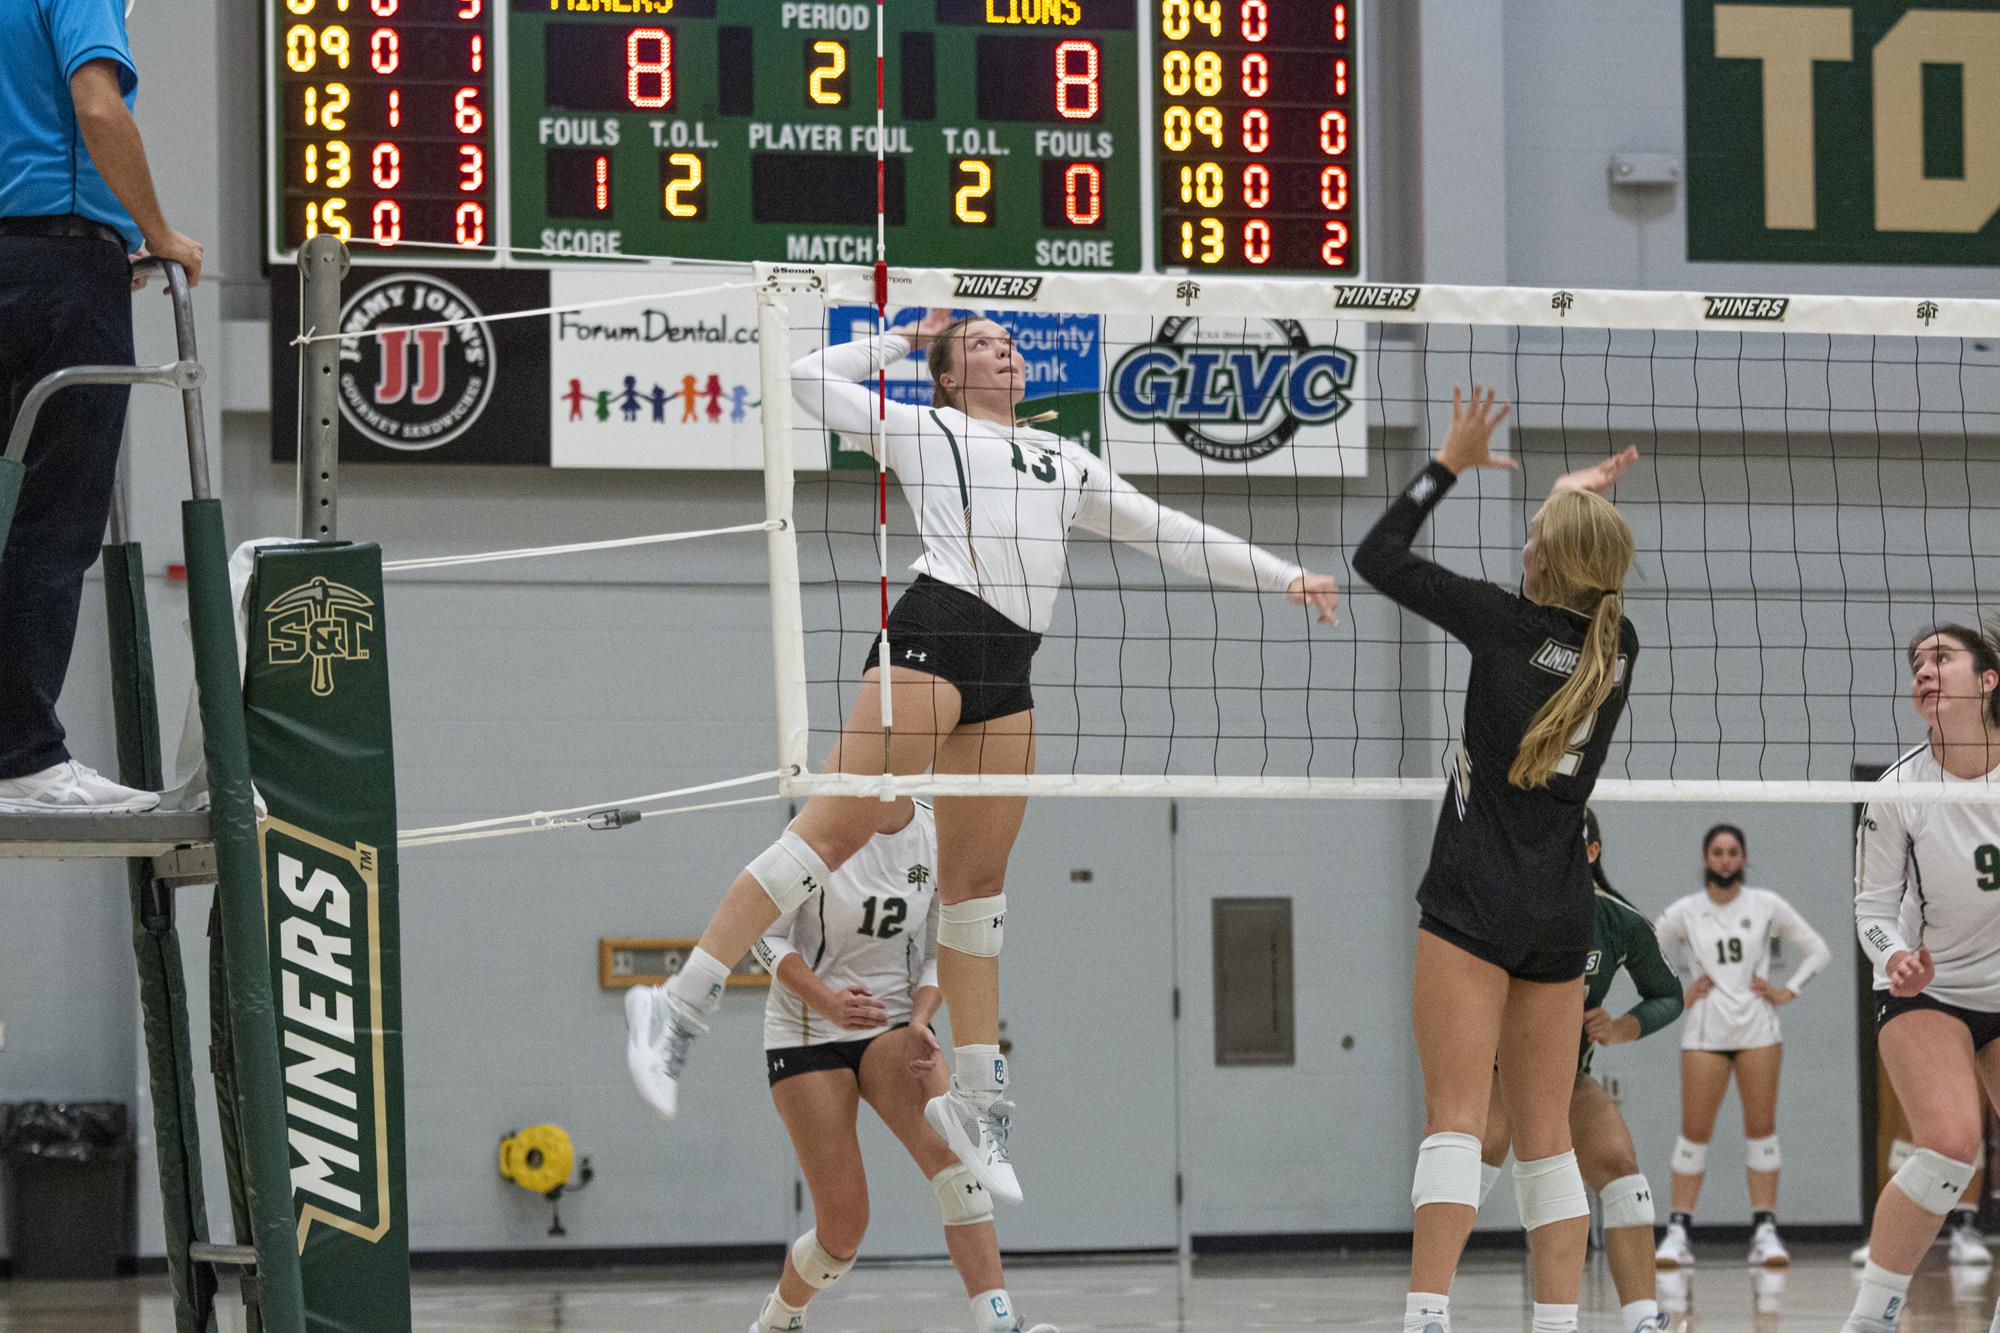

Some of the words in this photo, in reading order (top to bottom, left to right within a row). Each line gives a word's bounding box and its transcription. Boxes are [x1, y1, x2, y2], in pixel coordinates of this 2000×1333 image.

[782, 4, 870, 31] PERIOD
[1162, 0, 1221, 40] 04
[1241, 0, 1268, 42] 0
[1335, 4, 1346, 41] 1
[287, 24, 349, 72] 09
[371, 27, 398, 74] 0
[472, 34, 482, 73] 1
[627, 27, 672, 108] 8
[809, 40, 846, 105] 2
[1055, 39, 1099, 119] 8
[1163, 50, 1222, 96] 08
[1242, 52, 1268, 97] 0
[1336, 59, 1346, 96] 1
[304, 83, 350, 131] 12
[389, 89, 399, 128] 1
[455, 87, 482, 134] 6
[1164, 106, 1222, 151] 09
[1243, 107, 1269, 153] 0
[1320, 110, 1347, 155] 0
[539, 118, 620, 147] FOULS
[650, 121, 718, 148] T.O.L.
[749, 123, 842, 151] PLAYER
[851, 126, 913, 153] FOUL
[943, 129, 1010, 155] T.O.L.
[1035, 130, 1114, 158] FOULS
[305, 140, 351, 188] 13
[373, 142, 400, 189] 0
[459, 145, 482, 191] 3
[596, 156, 607, 210] 1
[665, 153, 701, 217] 2
[1181, 162, 1223, 208] 10
[1244, 163, 1270, 209] 0
[1321, 165, 1348, 211] 0
[955, 160, 991, 223] 2
[1065, 162, 1100, 225] 0
[306, 198, 351, 244] 15
[373, 199, 400, 246] 0
[456, 202, 483, 249] 0
[541, 230, 621, 256] SCORE
[1181, 218, 1224, 263] 13
[1245, 219, 1271, 264] 0
[1322, 219, 1348, 266] 2
[787, 235, 873, 262] MATCH
[1035, 241, 1114, 267] SCORE
[958, 276, 1037, 296] MINERS
[1338, 287, 1416, 306] MINERS
[1708, 298, 1785, 317] MINERS
[340, 286, 404, 362] JIMMY
[559, 309, 759, 343] ForumDental.co
[375, 324, 449, 405] JJ
[1025, 355, 1068, 382] ank
[1109, 343, 1357, 425] GLVC
[1008, 442, 1056, 483] 13
[268, 604, 373, 664] S&T
[360, 849, 373, 872] TM
[1974, 844, 2000, 891] 9
[857, 896, 907, 939] 12
[1716, 937, 1743, 964] 19
[277, 852, 361, 1212] MINERS
